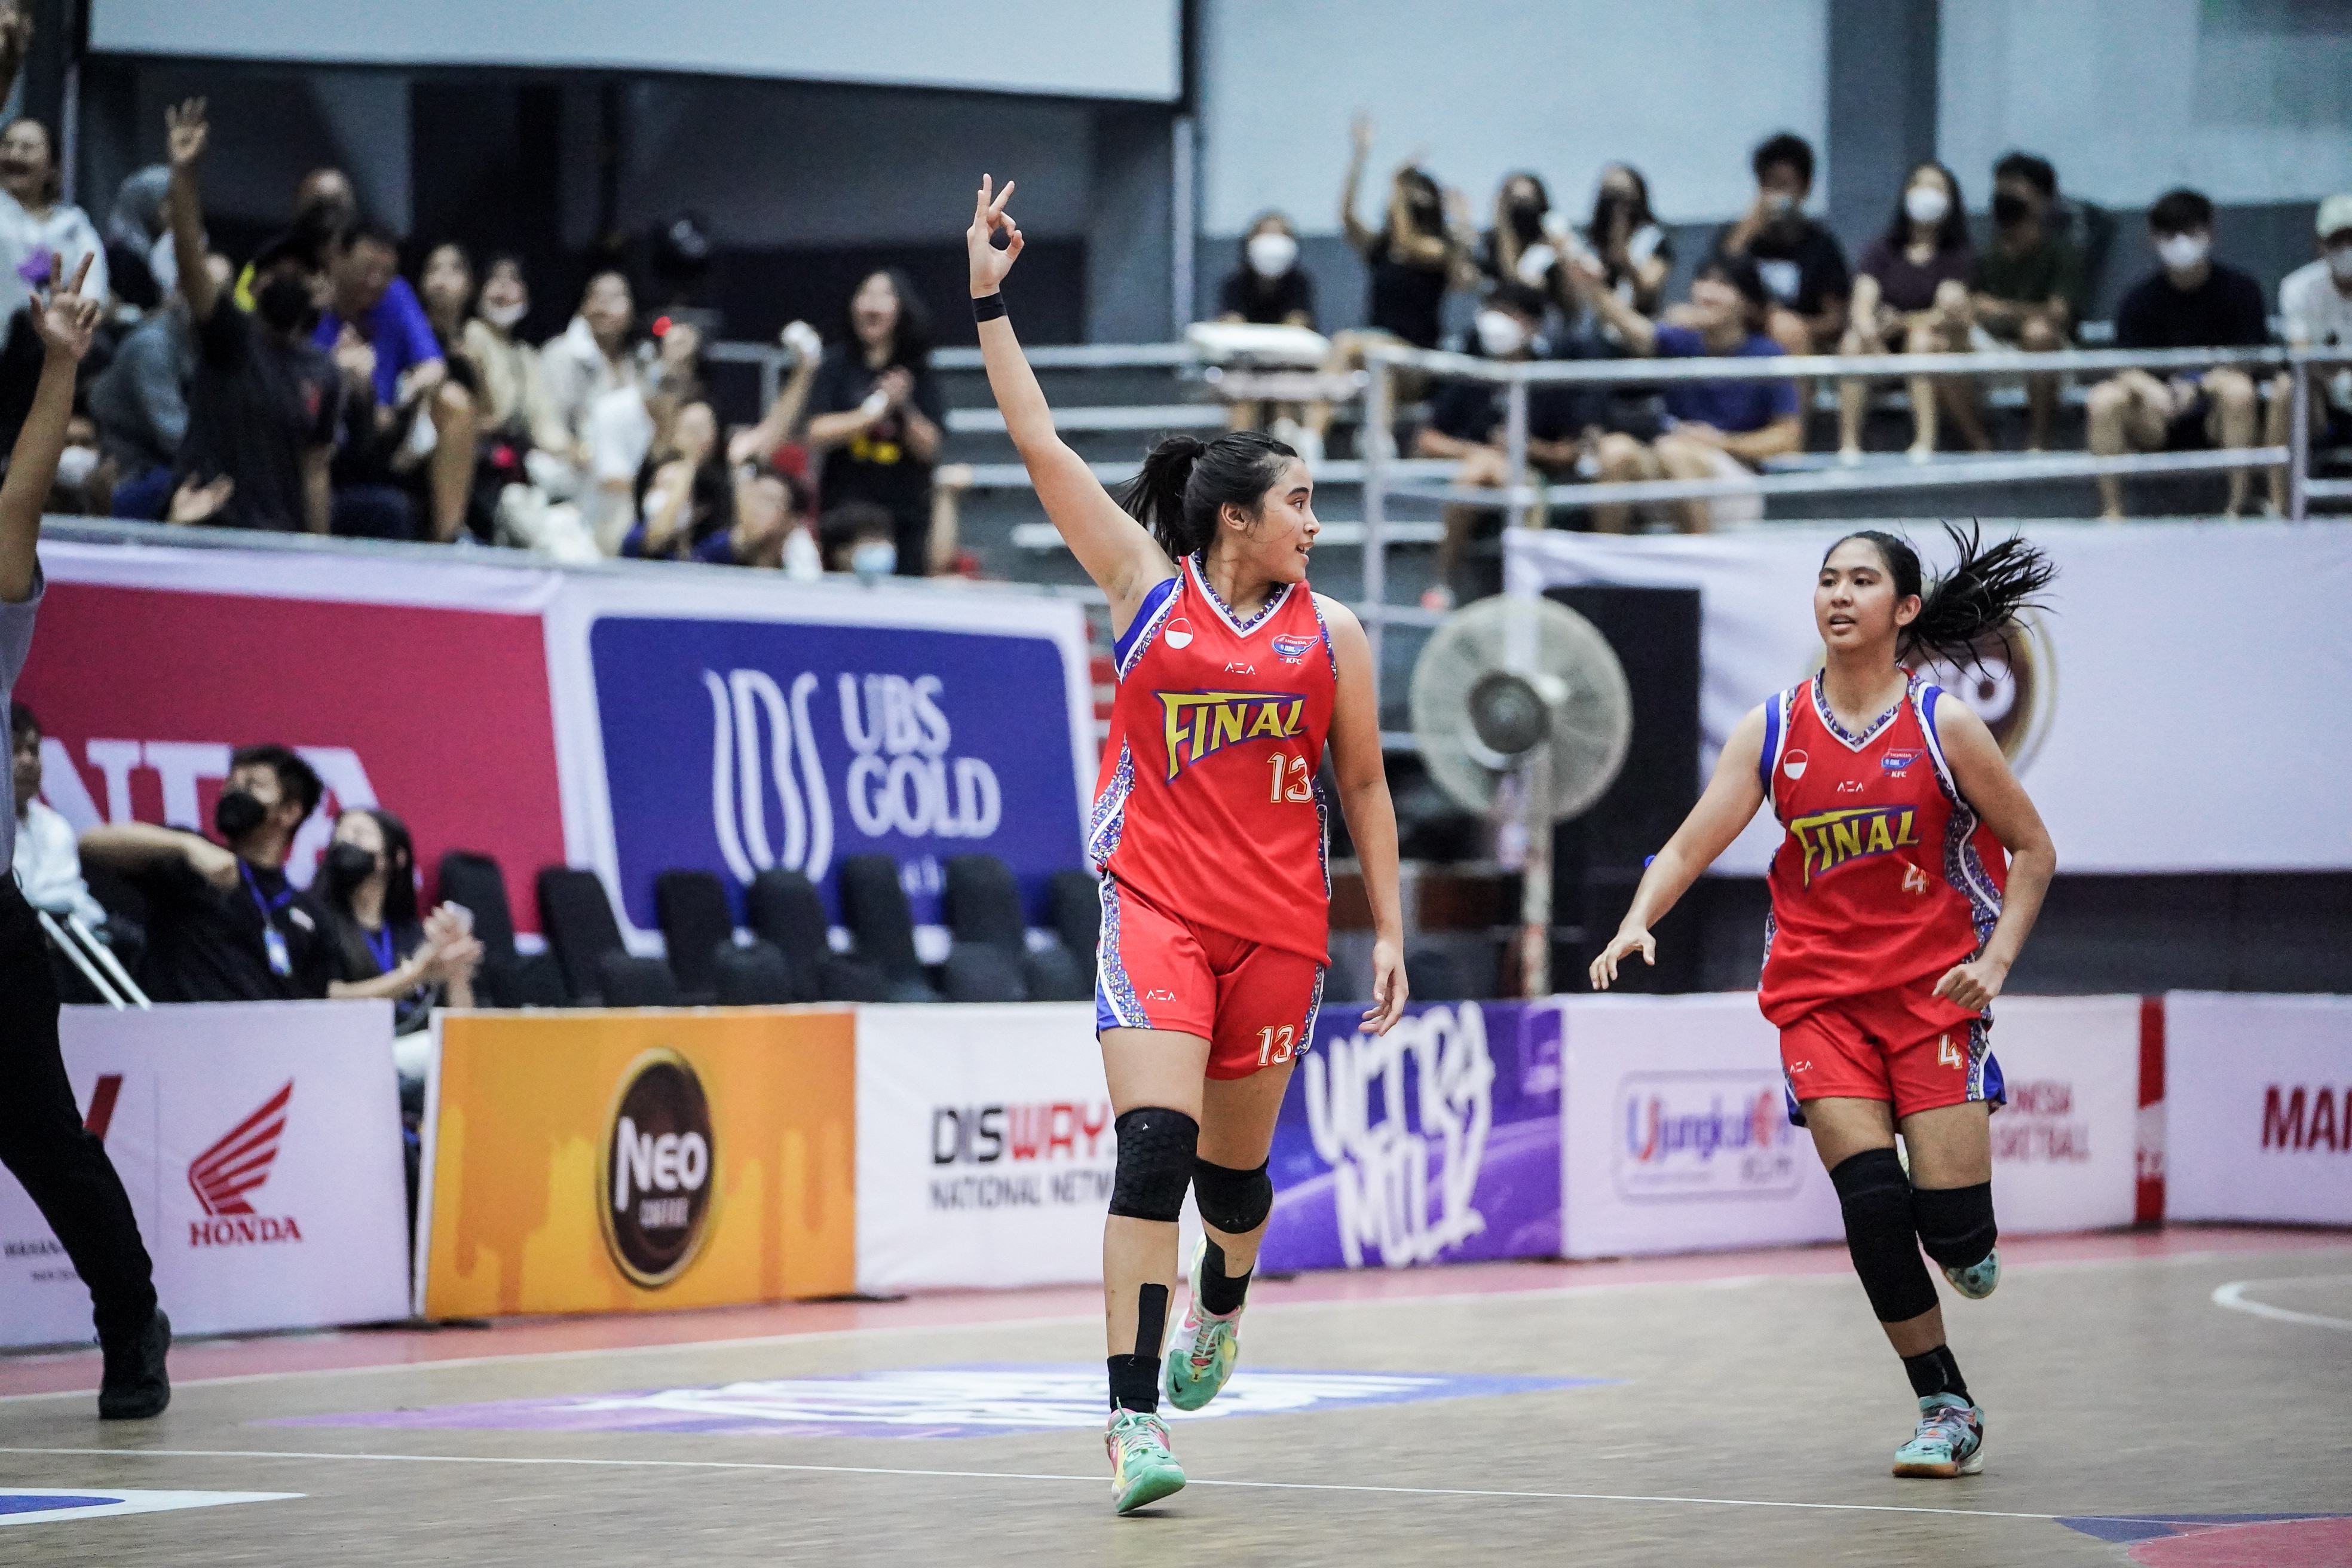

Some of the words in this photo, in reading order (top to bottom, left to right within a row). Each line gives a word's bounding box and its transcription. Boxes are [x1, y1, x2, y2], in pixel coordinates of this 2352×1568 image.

[838, 672, 951, 757] UBS
[1154, 690, 1307, 783] FINAL
[847, 755, 1002, 838] GOLD
[1267, 752, 1313, 803] 13
[1790, 807, 1919, 889] FINAL
[1902, 862, 1930, 895] 4
[1257, 1024, 1295, 1066] 13
[1938, 1033, 1962, 1070] 4
[614, 1115, 709, 1214] NEO
[930, 1174, 1042, 1209] NATIONAL
[189, 1216, 303, 1248] HONDA
